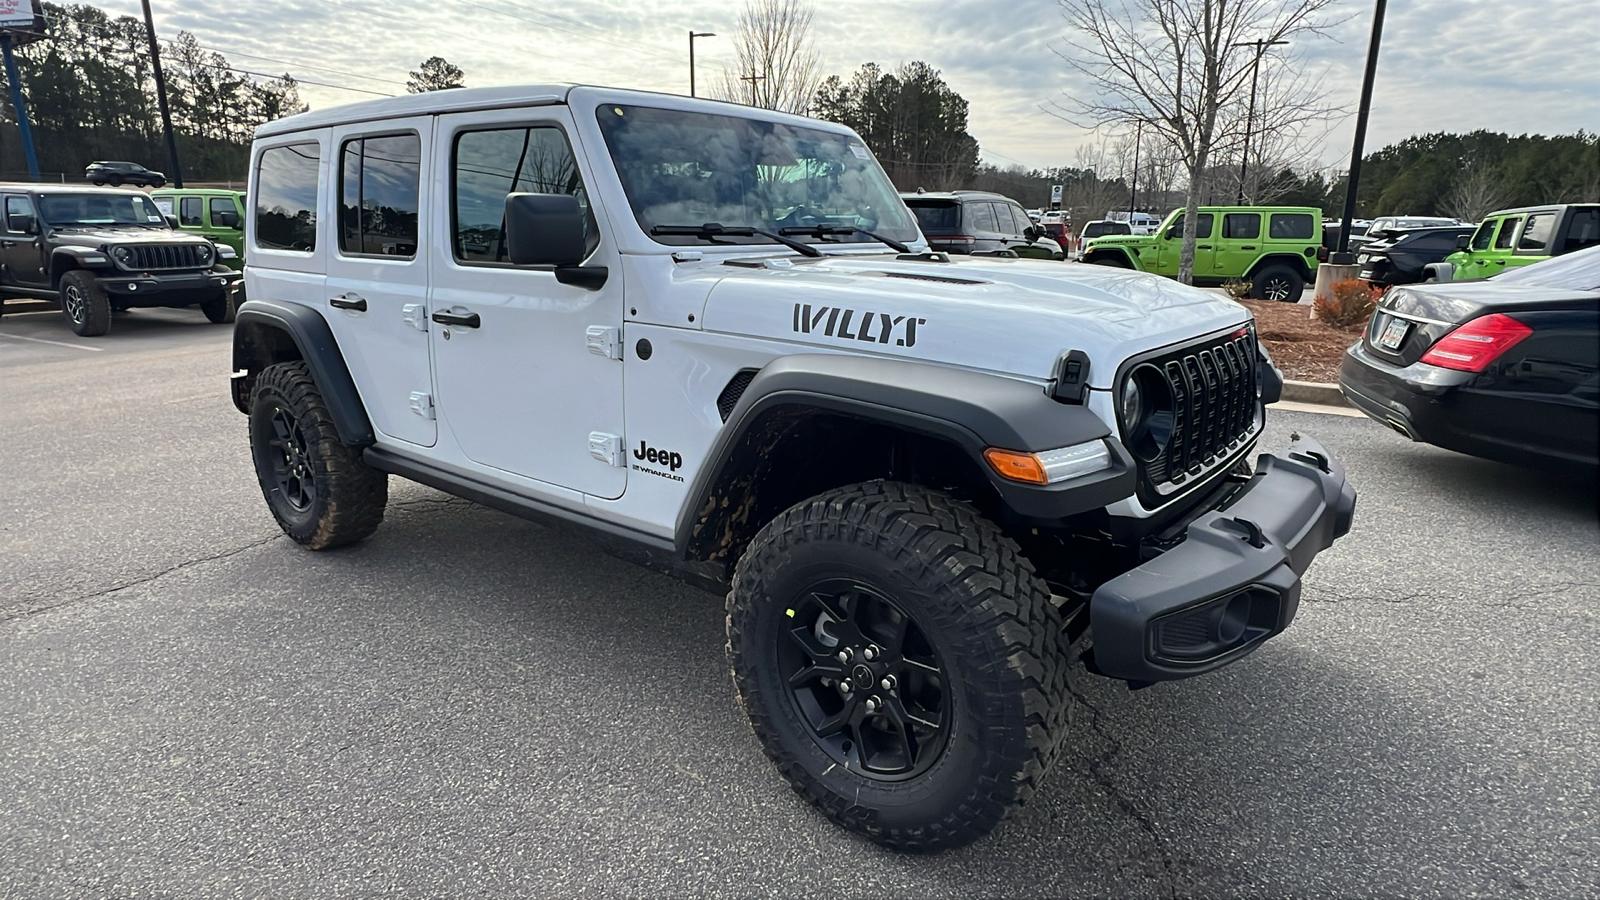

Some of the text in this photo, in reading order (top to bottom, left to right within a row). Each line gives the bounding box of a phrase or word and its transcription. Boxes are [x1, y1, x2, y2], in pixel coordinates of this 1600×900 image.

[793, 303, 927, 348] WILLYS
[633, 440, 683, 472] Jeep
[639, 466, 685, 483] WRANGLER
